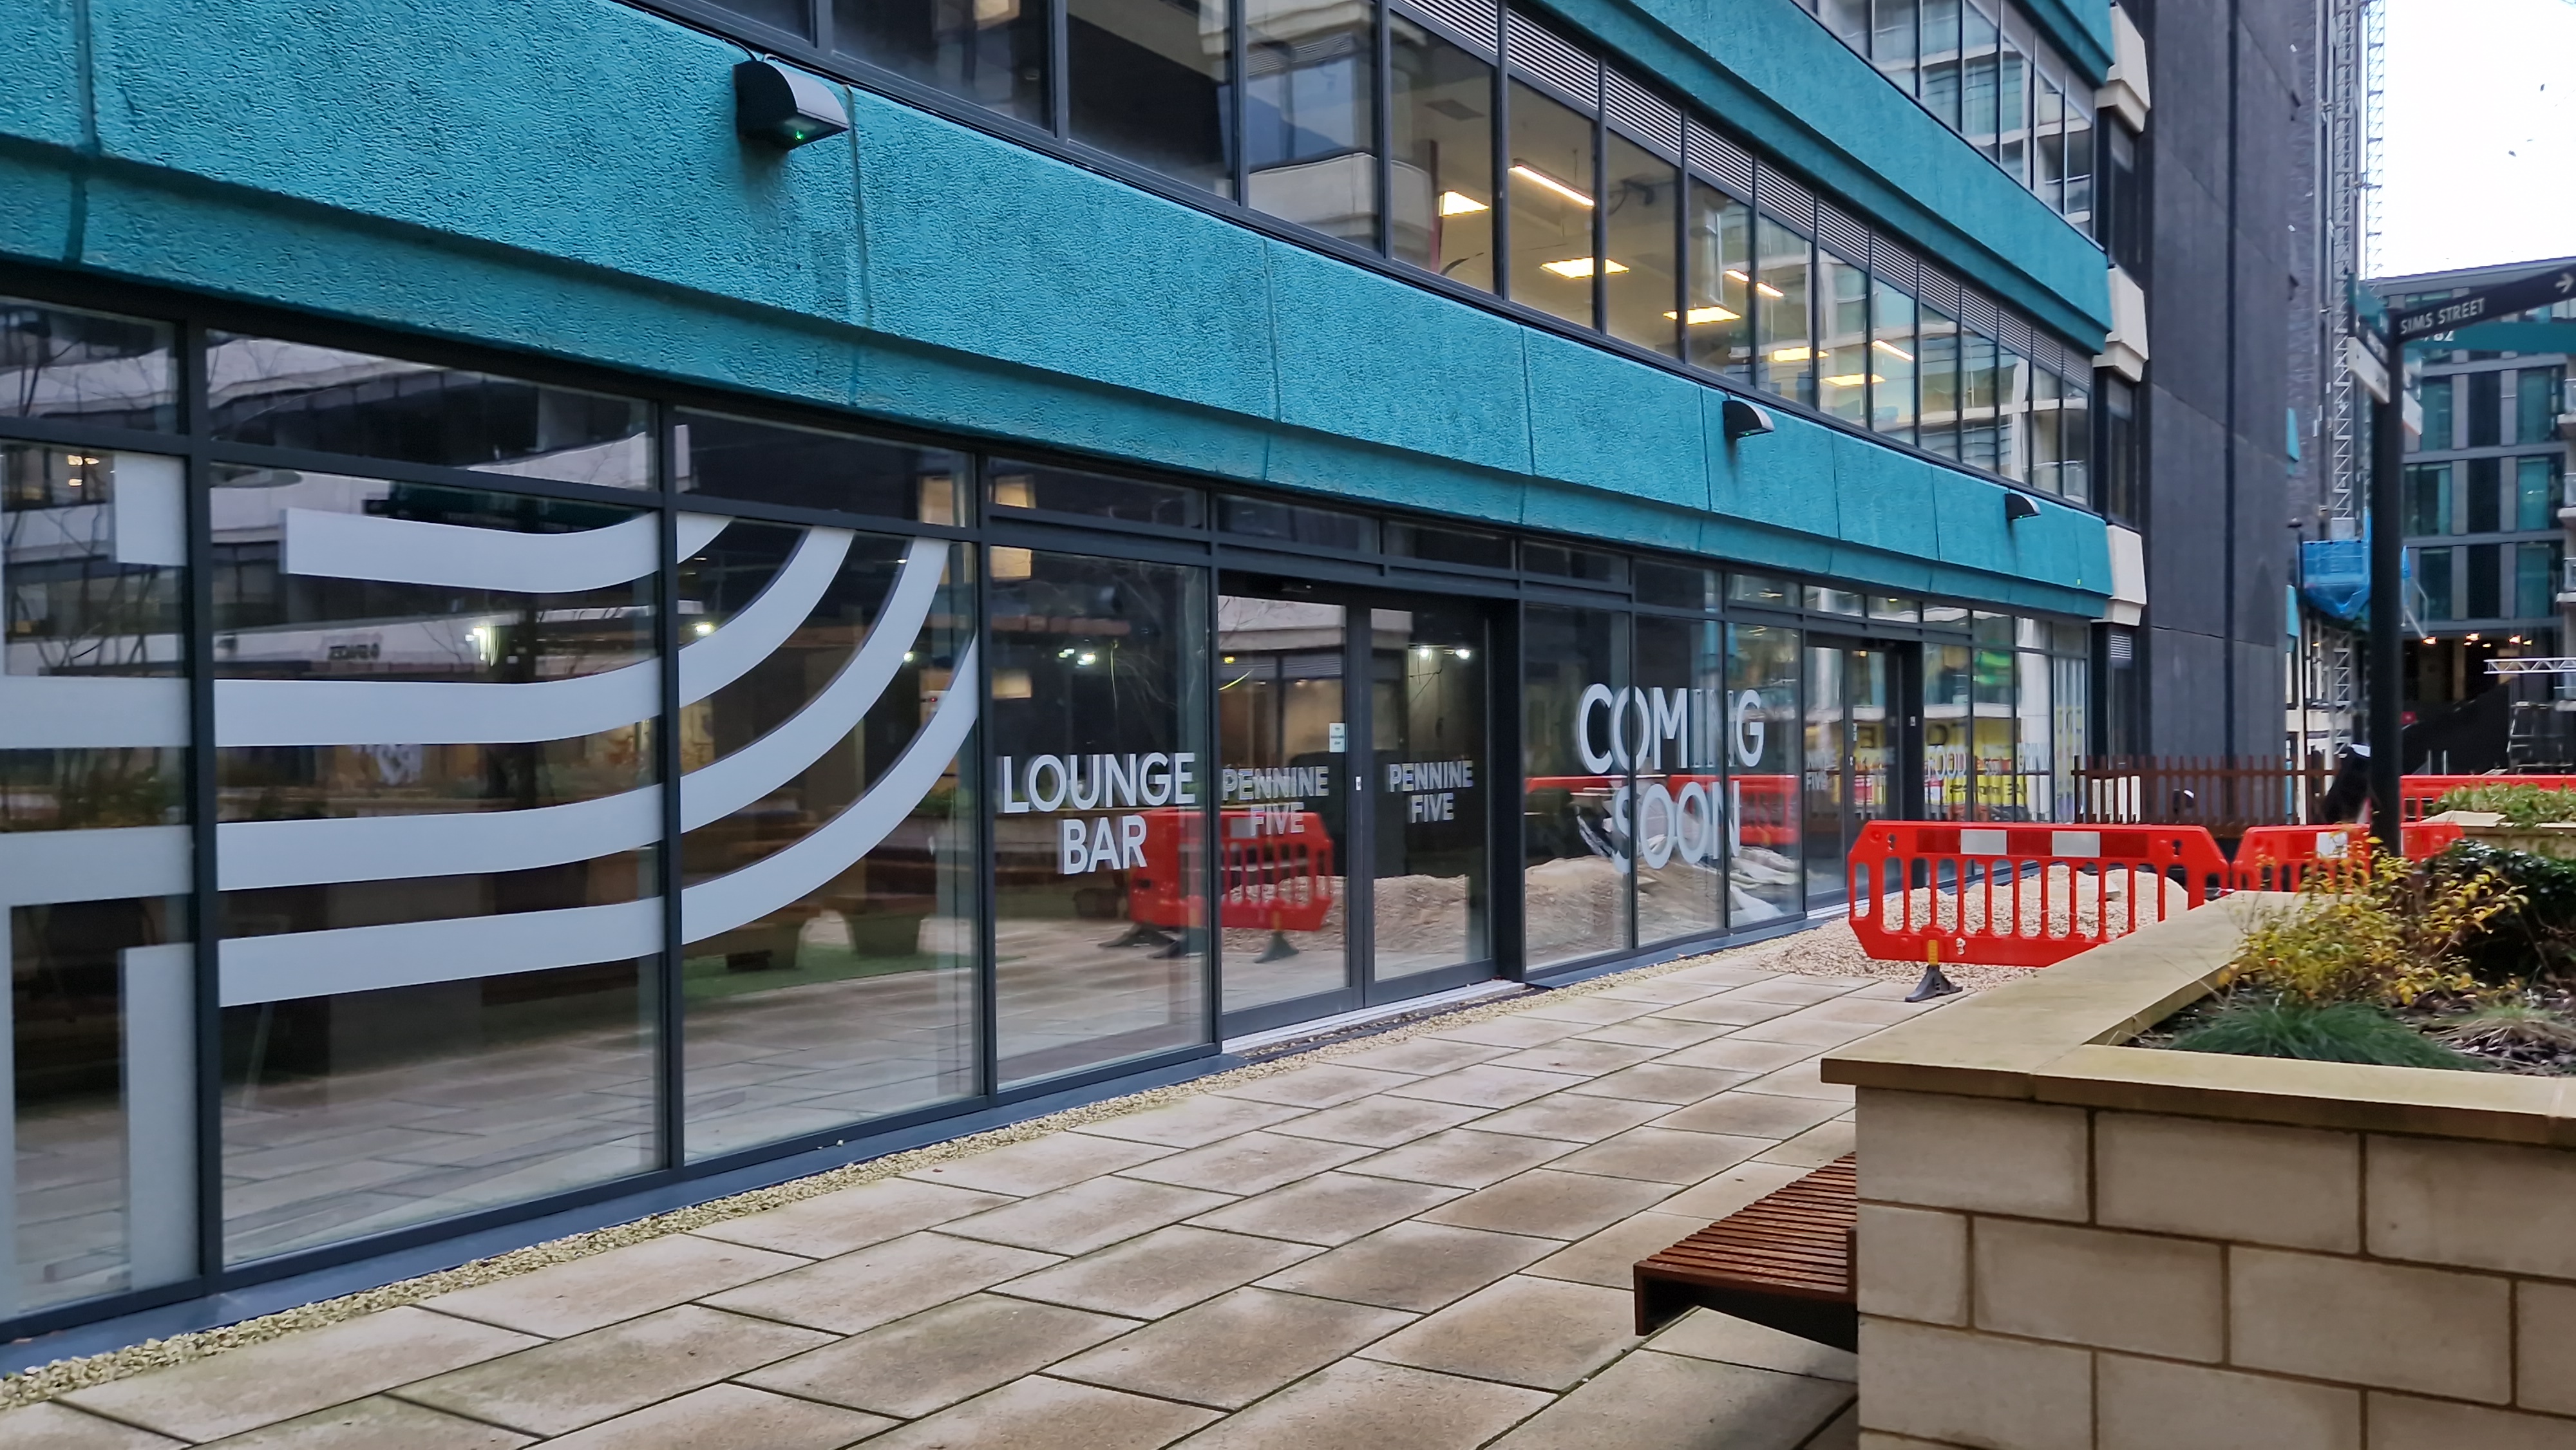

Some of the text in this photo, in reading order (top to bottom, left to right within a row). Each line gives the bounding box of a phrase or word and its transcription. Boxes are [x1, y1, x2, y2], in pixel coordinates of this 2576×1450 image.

[2400, 297, 2485, 334] SIMS STREET
[1579, 683, 1764, 774] COMING
[1003, 752, 1196, 814] LOUNGE
[1222, 766, 1329, 801] PENNINE
[1388, 760, 1473, 793] PENNINE
[1250, 802, 1305, 836] FIVE
[1410, 792, 1454, 824] FIVE
[1063, 815, 1148, 875] BAR
